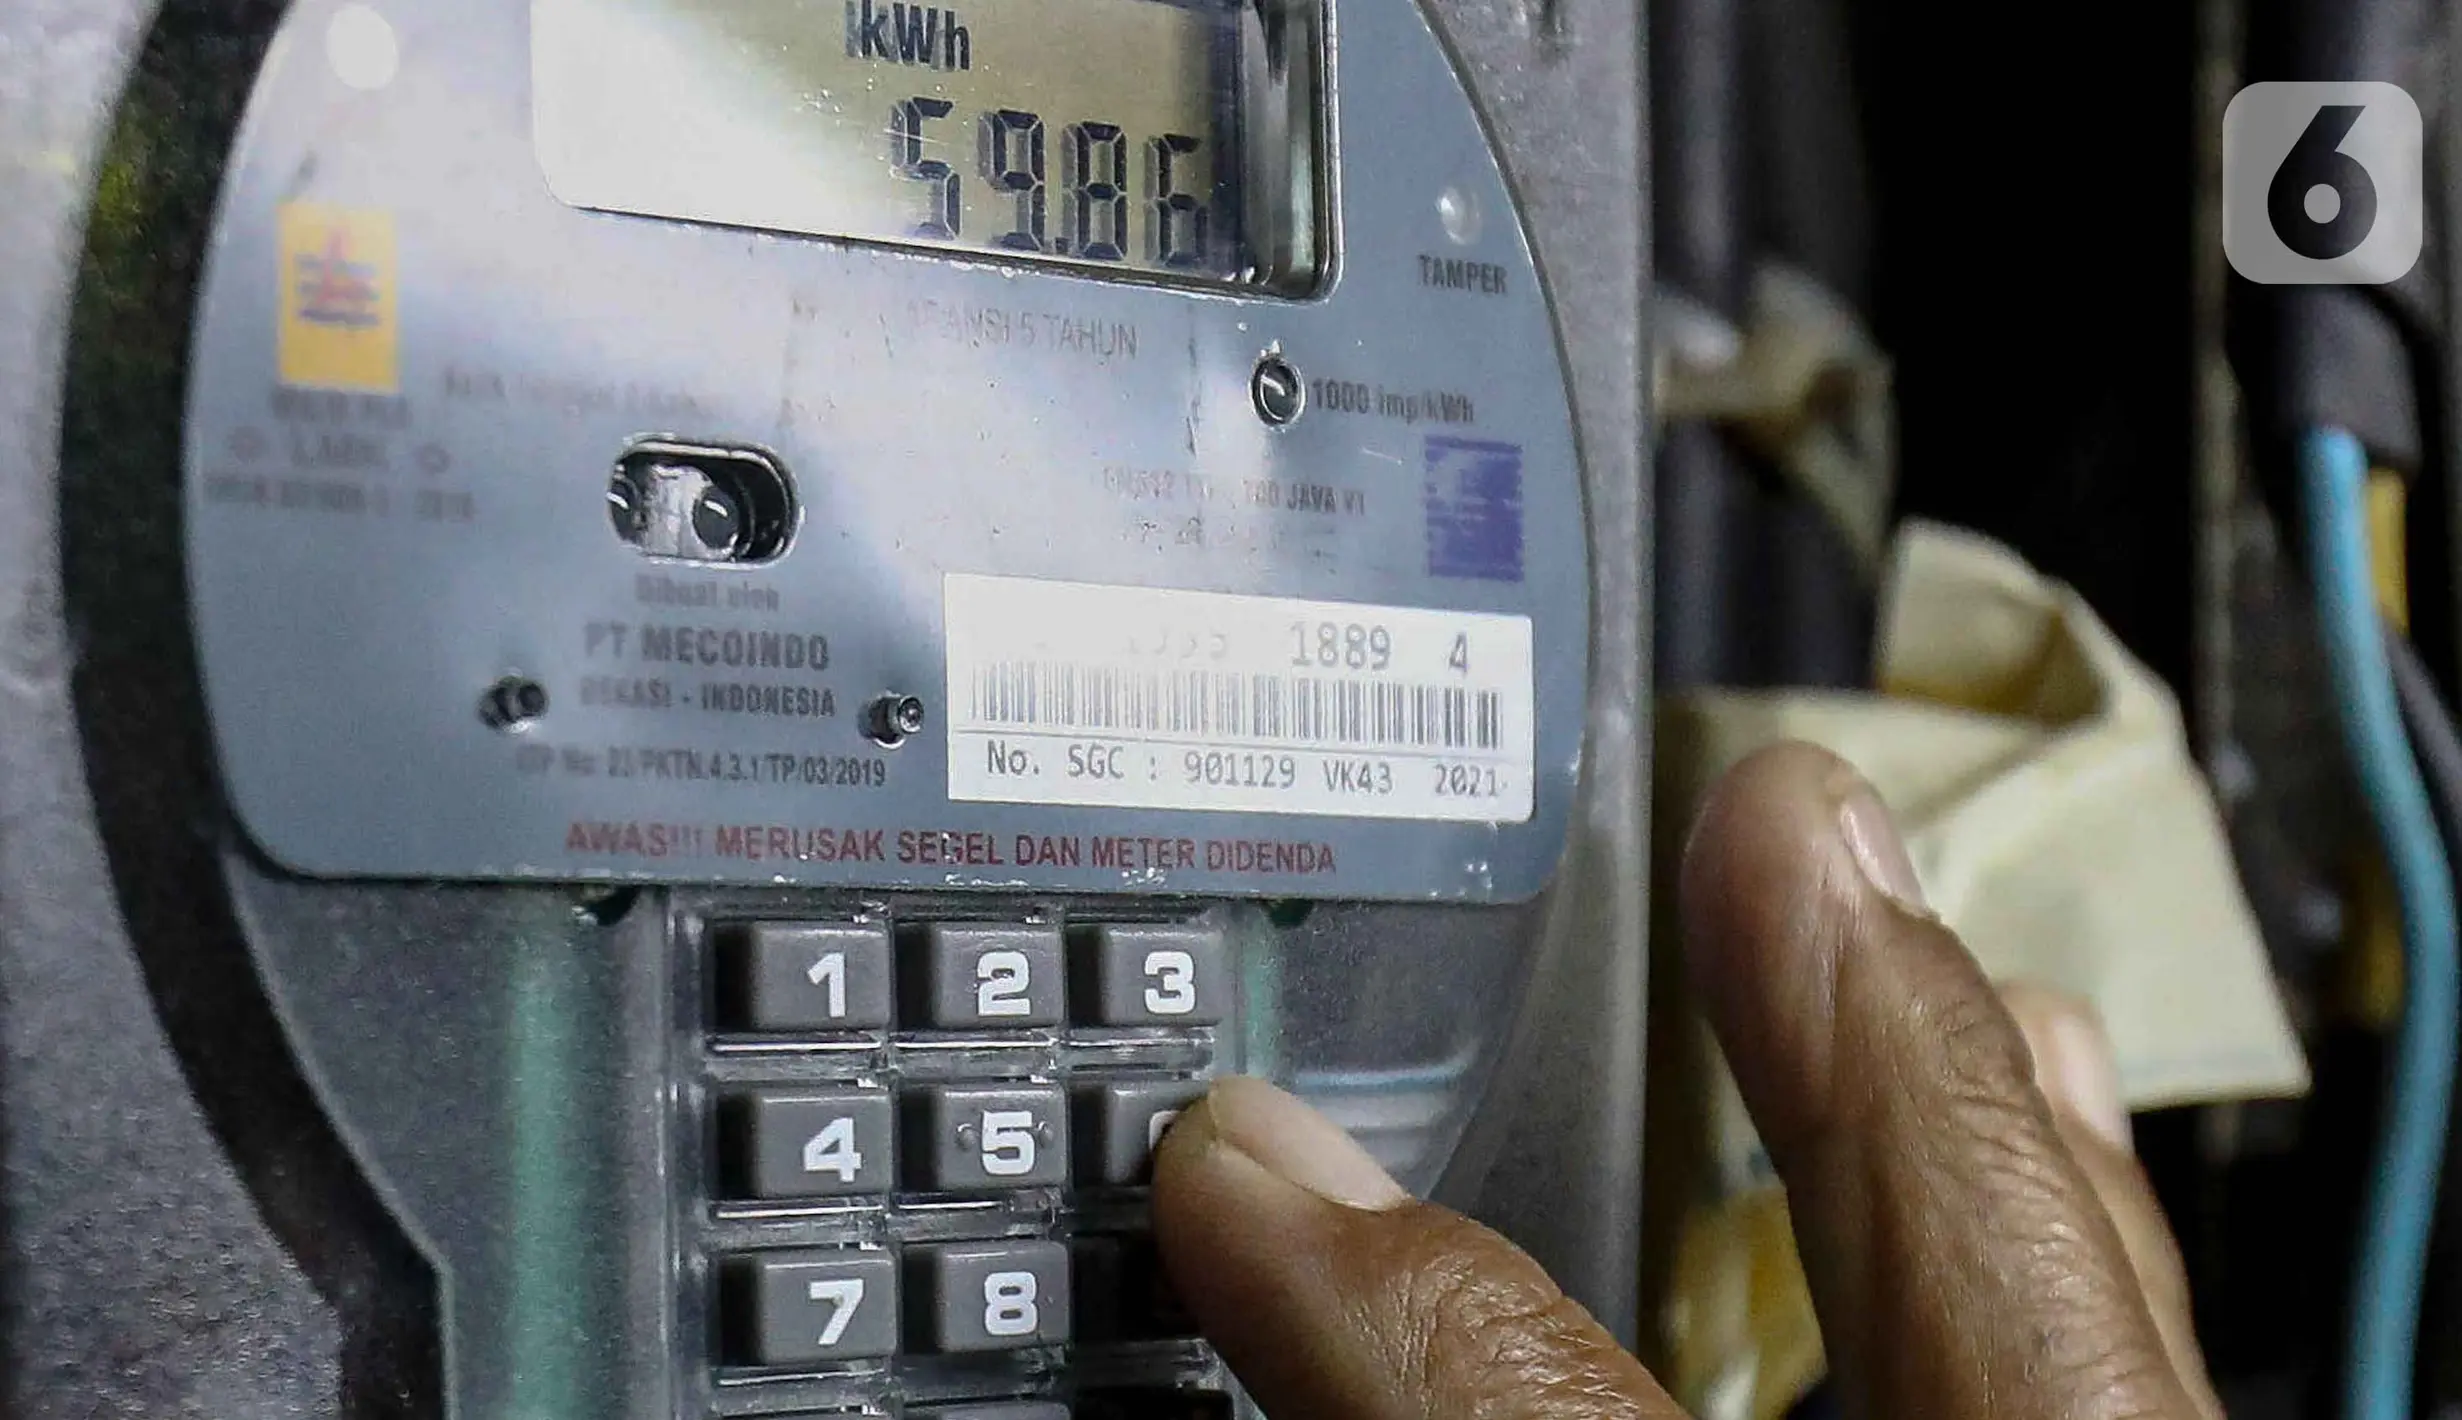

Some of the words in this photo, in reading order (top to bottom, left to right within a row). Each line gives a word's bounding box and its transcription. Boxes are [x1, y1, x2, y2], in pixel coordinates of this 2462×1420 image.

[850, 0, 971, 71] kWh
[1418, 254, 1508, 295] TAMPER
[1043, 314, 1137, 359] TAHUN
[1312, 378, 1370, 414] 1000
[1286, 482, 1337, 514] JAVA
[641, 624, 830, 671] MECOINDO
[1289, 621, 1392, 671] 1889
[1447, 631, 1470, 673] 4
[701, 684, 835, 718] INDONESIA
[987, 740, 1041, 777] No.
[1067, 744, 1125, 779] SGC
[1184, 751, 1296, 790] 901129
[1323, 760, 1394, 795] VK43
[565, 822, 701, 857] AWAS!!!
[714, 824, 885, 862] MERUSAK
[897, 830, 1004, 865] SEGEL
[1015, 834, 1081, 867] DAN
[1091, 836, 1195, 870] METER
[1206, 840, 1337, 873] DIDENDA
[806, 952, 846, 1017] 1
[976, 950, 1031, 1016] 2
[1143, 950, 1196, 1014] 3
[803, 1117, 862, 1182] 4
[981, 1109, 1036, 1175] 5
[810, 1278, 863, 1345] 7
[984, 1271, 1037, 1335] 8
